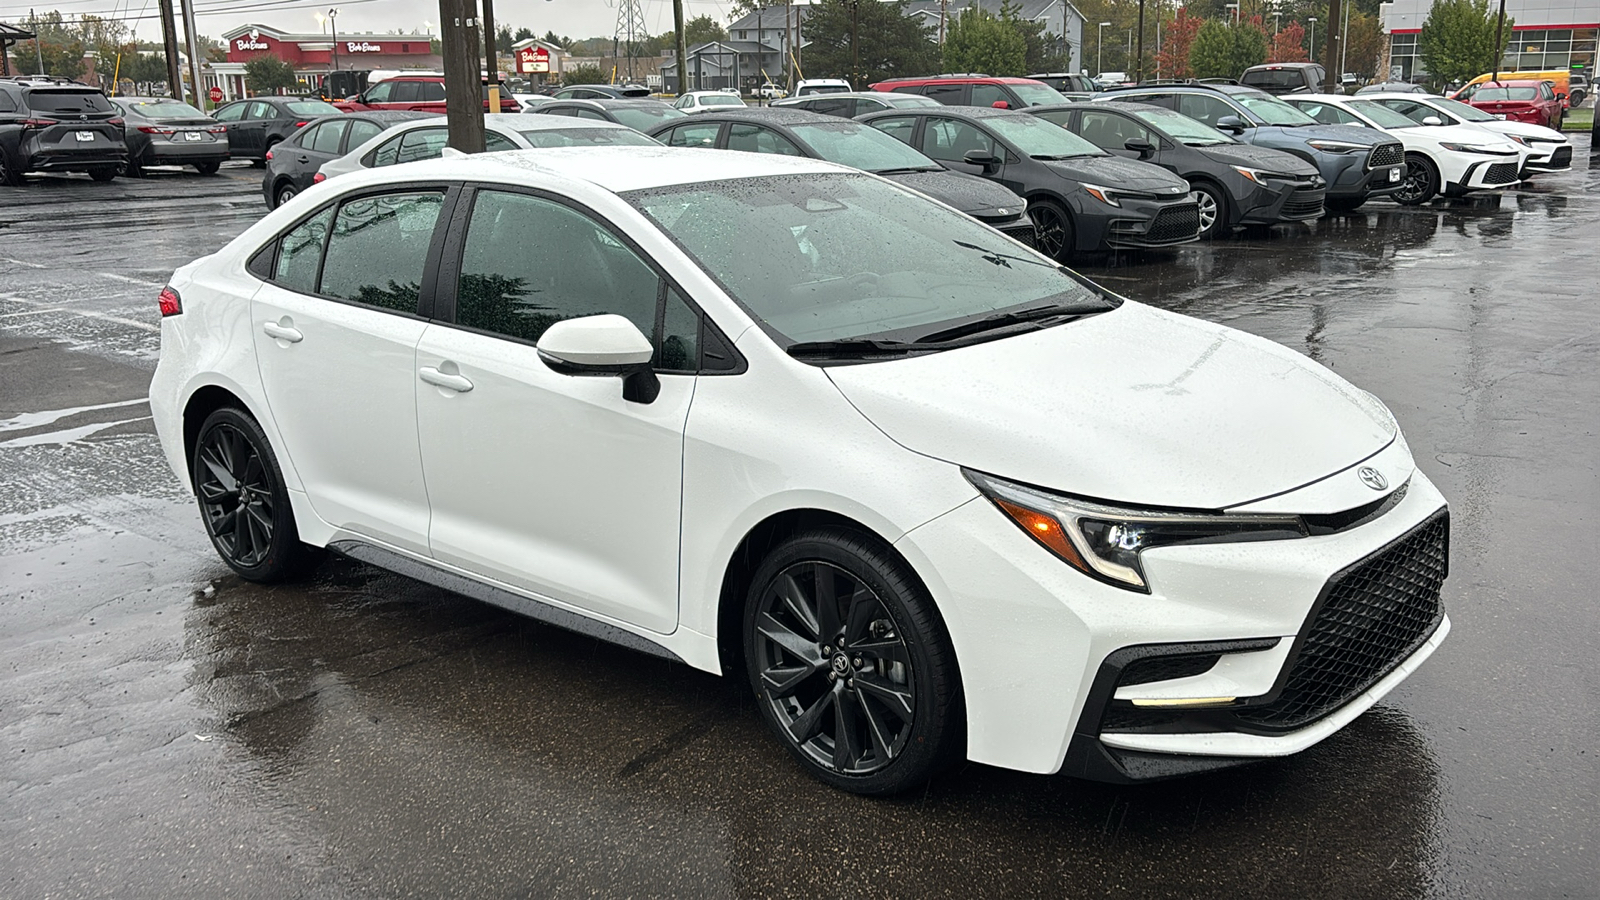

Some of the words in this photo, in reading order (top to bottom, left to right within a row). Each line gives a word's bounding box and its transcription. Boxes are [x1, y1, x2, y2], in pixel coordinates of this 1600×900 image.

[236, 40, 250, 50] Bob
[250, 40, 268, 50] Evans
[347, 42, 362, 52] Bob
[362, 42, 381, 52] Evans
[521, 51, 533, 61] Bob
[533, 51, 548, 61] Evans
